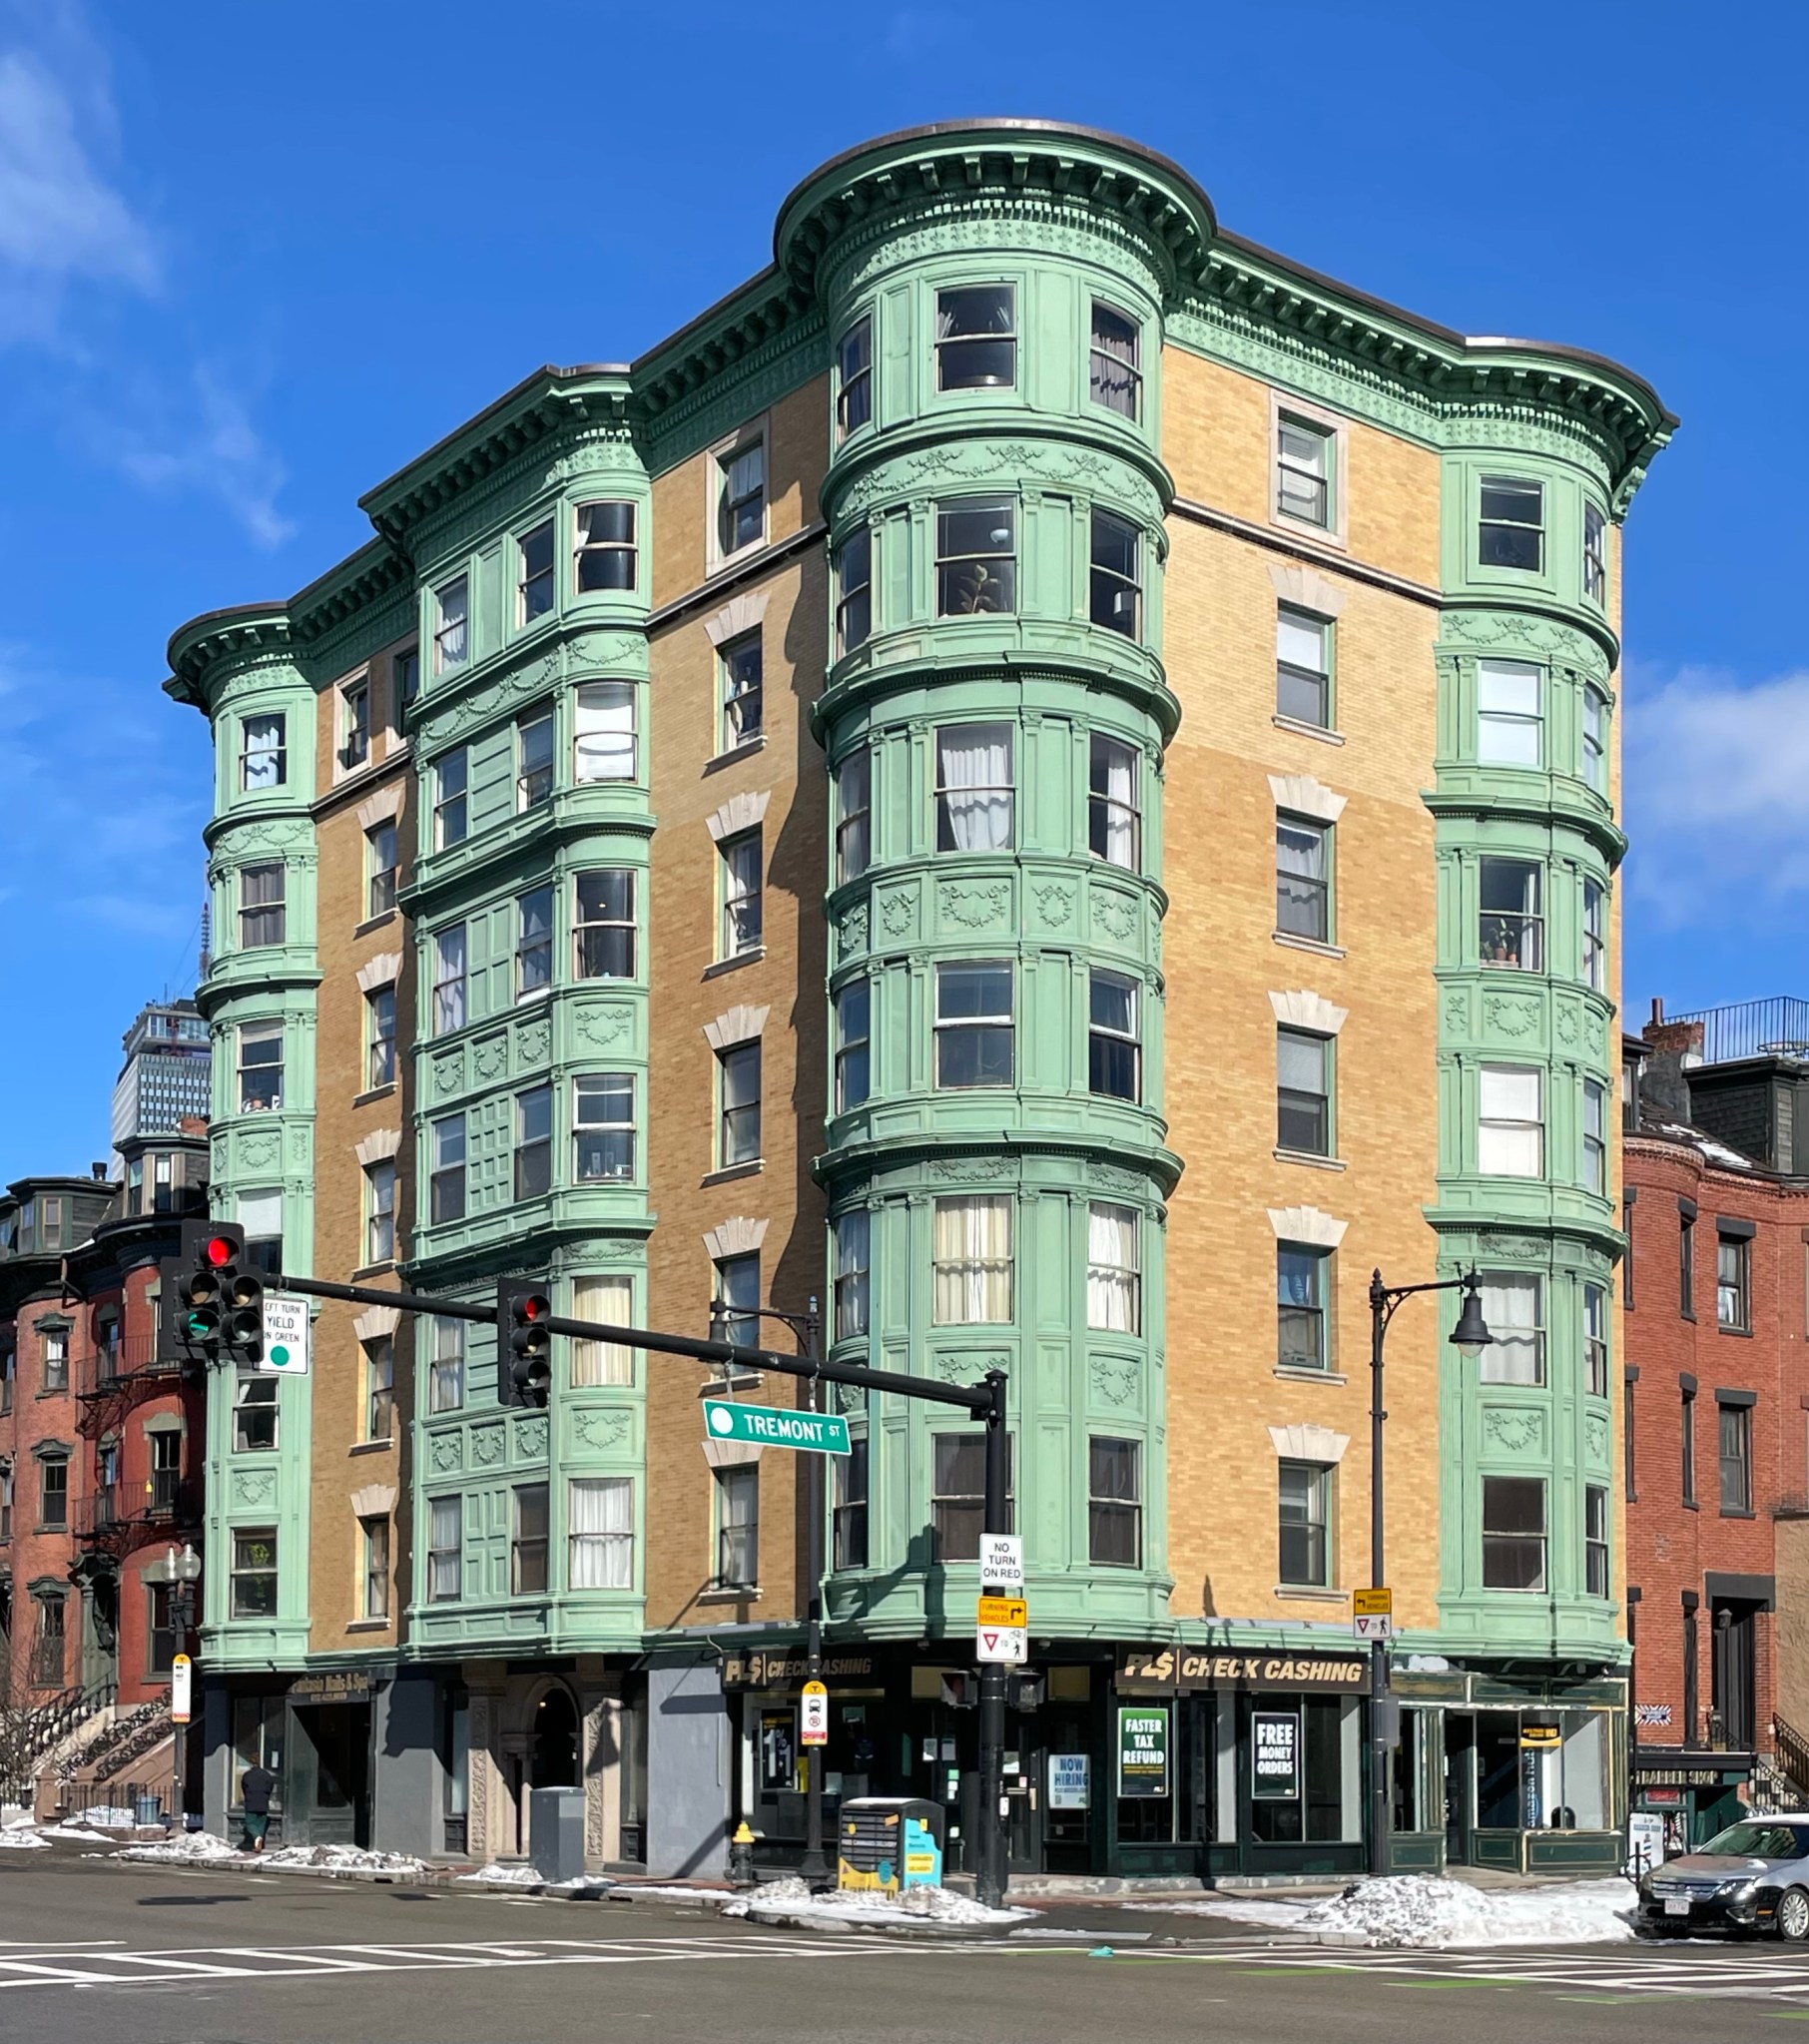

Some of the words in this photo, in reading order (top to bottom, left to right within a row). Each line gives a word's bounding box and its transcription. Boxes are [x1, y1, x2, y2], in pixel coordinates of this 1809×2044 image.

[265, 1302, 279, 1312] EFT
[282, 1304, 301, 1314] TURN
[268, 1316, 295, 1329] YIELD
[275, 1332, 300, 1342] GREEN
[744, 1414, 824, 1442] TREMONT
[829, 1425, 841, 1437] ST
[994, 1543, 1009, 1553] NO
[988, 1555, 1016, 1566] TURN
[983, 1568, 997, 1578] ON
[1000, 1569, 1020, 1579] RED
[767, 1661, 809, 1678] CHECK
[1182, 1657, 1261, 1679] CHECK
[1264, 1660, 1362, 1682] CASHING
[1125, 1718, 1162, 1732] FASTER
[1134, 1734, 1154, 1748] TAX
[1257, 1723, 1293, 1745] FREE
[1123, 1750, 1164, 1764] REFUND
[1258, 1746, 1292, 1759] MONEY
[1060, 1758, 1083, 1771] NOW
[1257, 1760, 1293, 1774] ORDERS
[1054, 1772, 1089, 1786] HIRING
[1641, 1769, 1687, 1785] BARBER
[1688, 1769, 1718, 1785] SHOP
